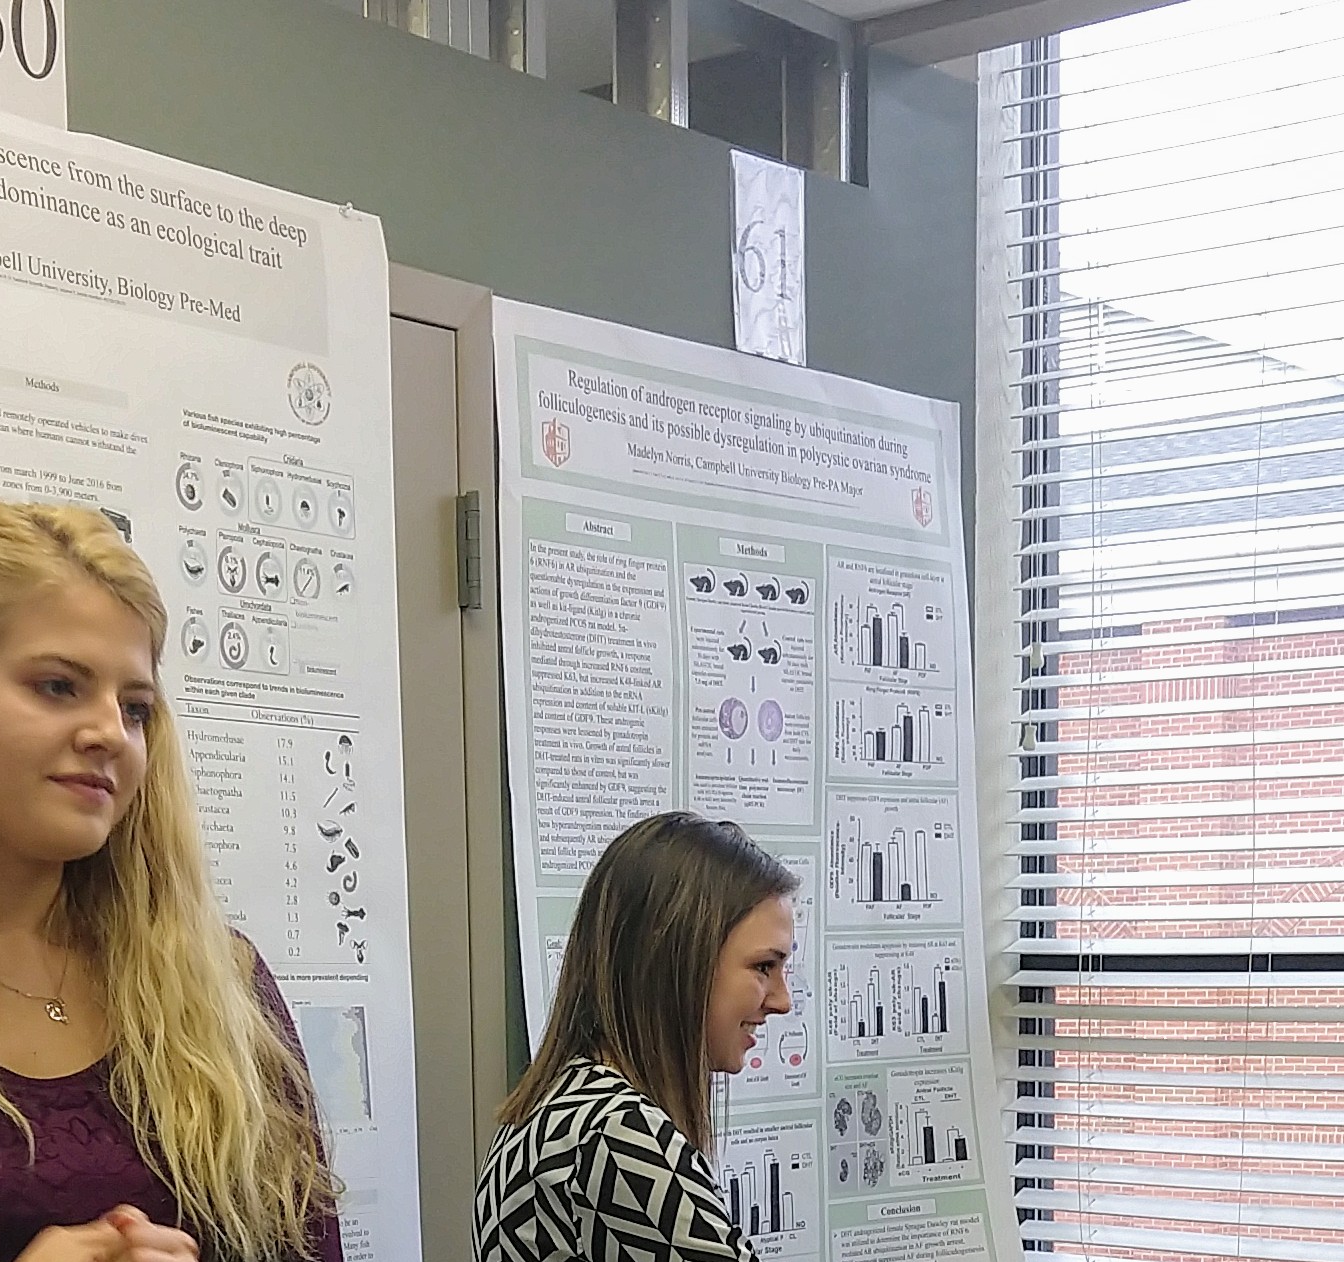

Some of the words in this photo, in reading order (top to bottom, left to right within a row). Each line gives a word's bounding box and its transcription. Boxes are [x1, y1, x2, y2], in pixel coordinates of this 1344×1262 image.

[67, 160, 112, 191] from
[117, 173, 144, 199] the
[150, 188, 212, 217] surface
[216, 203, 233, 223] to
[238, 207, 264, 231] the
[268, 215, 306, 247] deep
[106, 211, 125, 229] as
[130, 217, 151, 236] an
[156, 224, 244, 260] ecological
[248, 244, 282, 269] trait
[738, 219, 792, 301] 61
[28, 255, 113, 295] University,
[118, 276, 175, 311] Biology
[179, 291, 240, 322] Pre-Med
[25, 376, 59, 392] Methods
[538, 389, 626, 425] folliculogenesis
[628, 412, 648, 429] and
[652, 414, 664, 433] its
[667, 422, 710, 442] possible
[713, 427, 784, 455] dysregulation
[787, 441, 797, 458] in
[799, 445, 849, 468] polycystic
[852, 457, 887, 474] ovarian
[889, 464, 931, 483] syndrome
[568, 369, 628, 399] Regulation
[630, 385, 644, 402] of
[645, 389, 695, 415] androgen
[698, 402, 741, 423] receptor
[744, 407, 791, 436] signaling
[794, 417, 806, 438] by
[809, 421, 875, 448] ubiquitination
[878, 435, 908, 459] during
[627, 442, 663, 464] Madelyn
[665, 449, 693, 469] Norris,
[695, 456, 735, 475] Campbell
[737, 462, 779, 485] University
[780, 470, 810, 490] Biology
[812, 476, 839, 492] Pre-PA
[840, 481, 863, 498] Major
[583, 520, 613, 535] Abstract
[736, 543, 767, 558] Methods
[277, 737, 292, 748] 17.9
[880, 1205, 921, 1216] Conclusion
